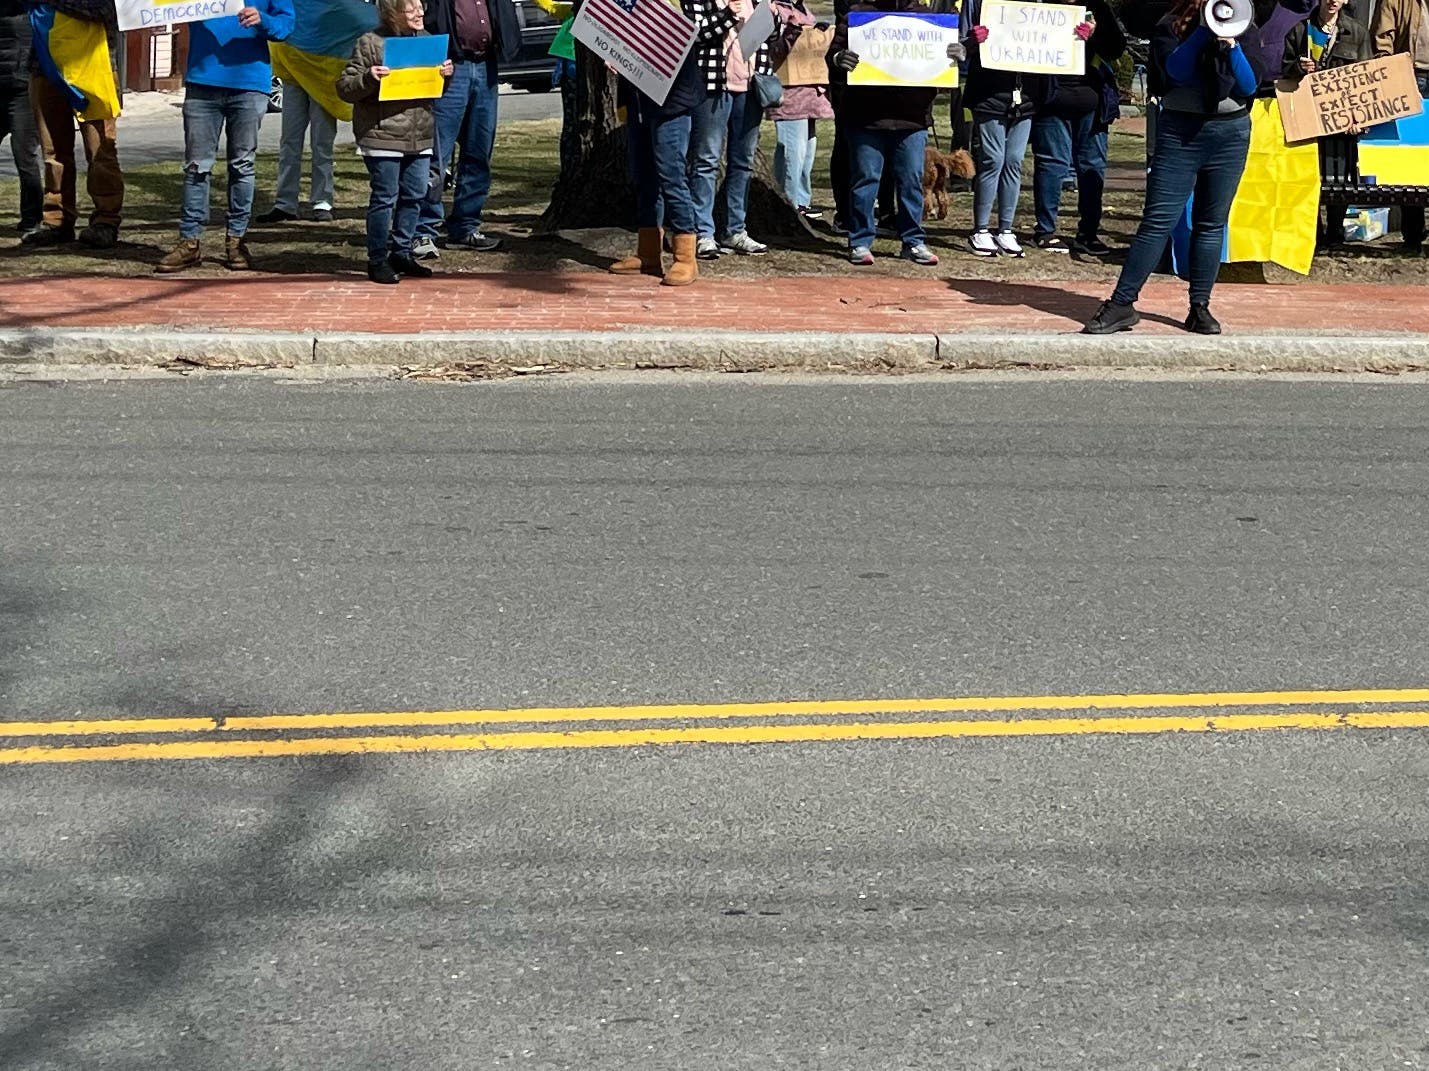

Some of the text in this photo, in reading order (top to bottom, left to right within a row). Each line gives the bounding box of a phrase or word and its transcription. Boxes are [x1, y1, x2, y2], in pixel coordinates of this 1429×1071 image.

[140, 0, 228, 26] DEMOCRACY
[1016, 6, 1066, 27] STAND
[862, 27, 943, 43] WE STAND WITH
[1011, 29, 1047, 44] WITH
[868, 42, 936, 60] UKRAINE
[990, 46, 1067, 68] UKRAINE
[1310, 62, 1369, 84] RESPECT
[1310, 67, 1388, 97] EXISTENCE
[1319, 88, 1378, 112] EXPECT
[1319, 95, 1410, 134] RESISTANCE
